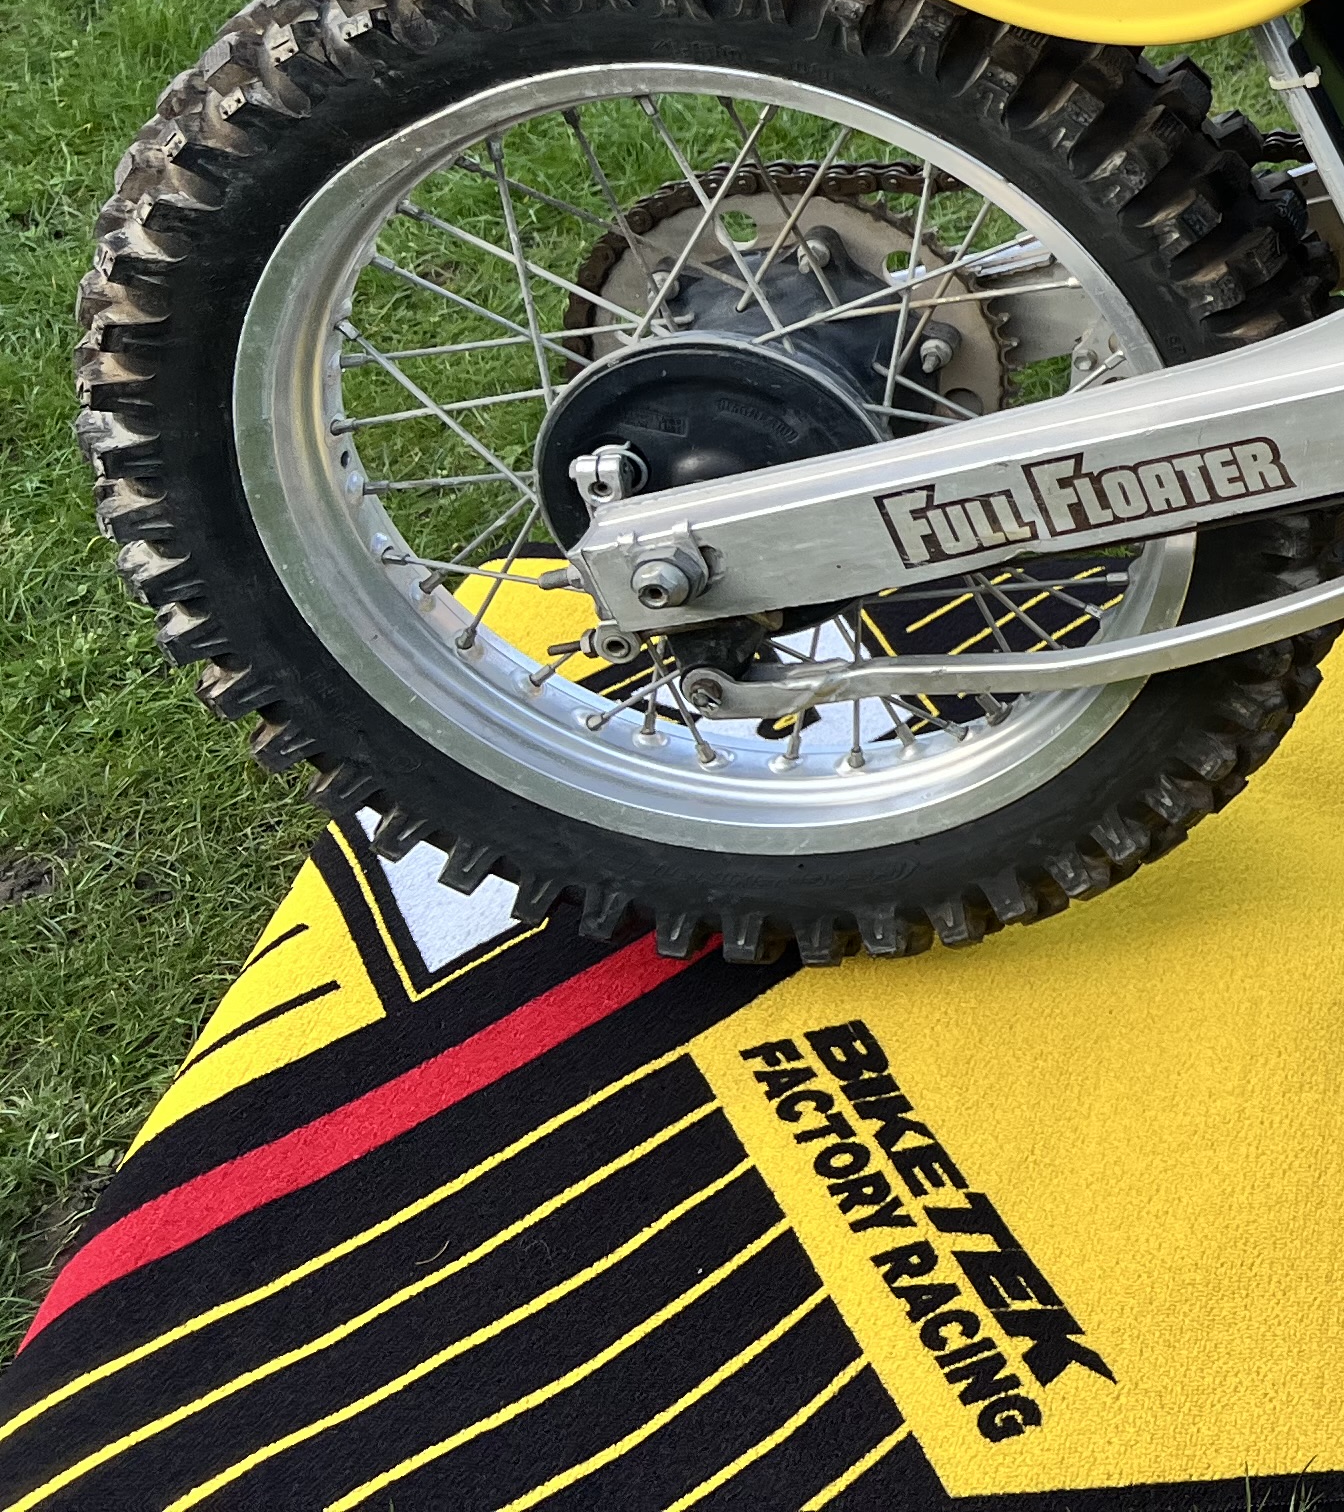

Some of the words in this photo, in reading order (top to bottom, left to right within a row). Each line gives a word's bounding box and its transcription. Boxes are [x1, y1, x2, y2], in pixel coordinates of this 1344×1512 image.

[874, 484, 1040, 569] FULL
[1021, 437, 1298, 537] FLOATER
[739, 1038, 914, 1234] FACTORY
[870, 1240, 1042, 1444] RACING
